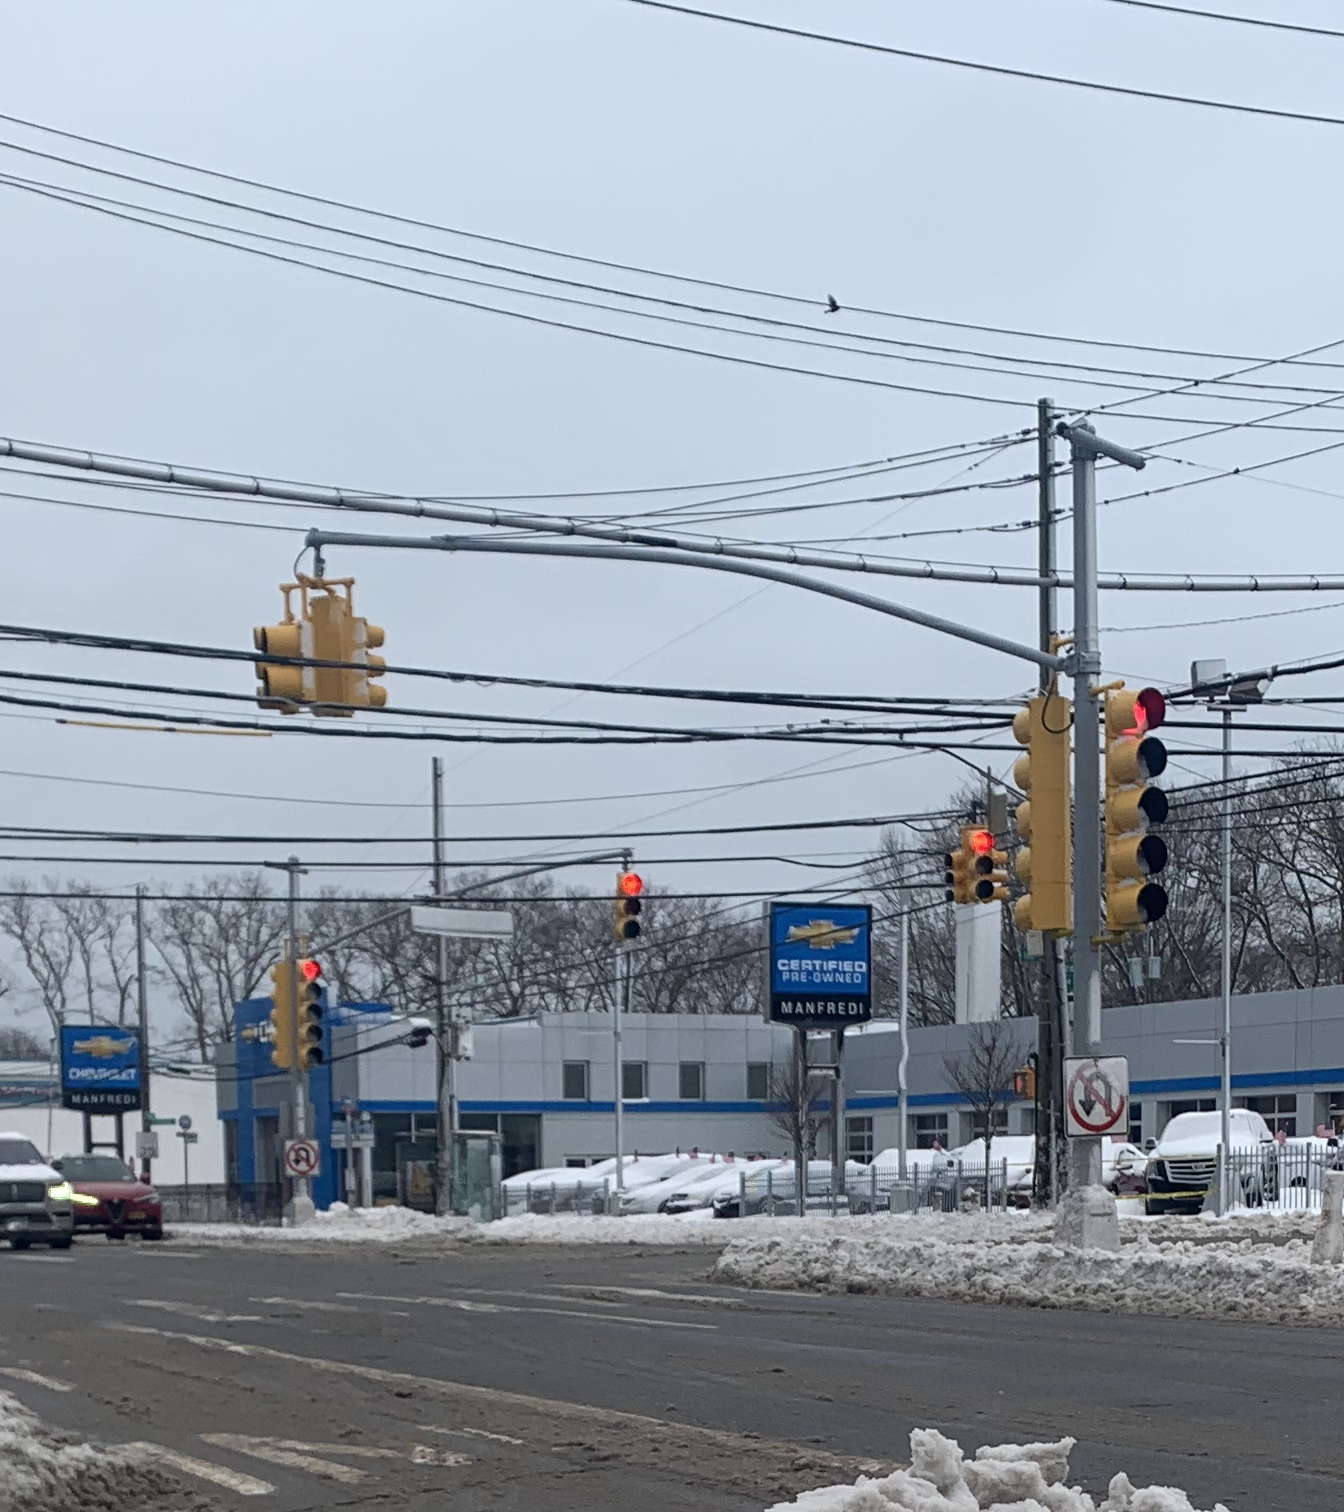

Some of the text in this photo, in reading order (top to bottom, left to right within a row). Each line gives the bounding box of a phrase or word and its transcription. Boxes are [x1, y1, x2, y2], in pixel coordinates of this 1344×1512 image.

[777, 959, 866, 972] CERTIFIED
[782, 971, 862, 984] PRE-OWNED
[781, 1001, 864, 1016] MANFREDI
[71, 1094, 136, 1104] MANFREDI
